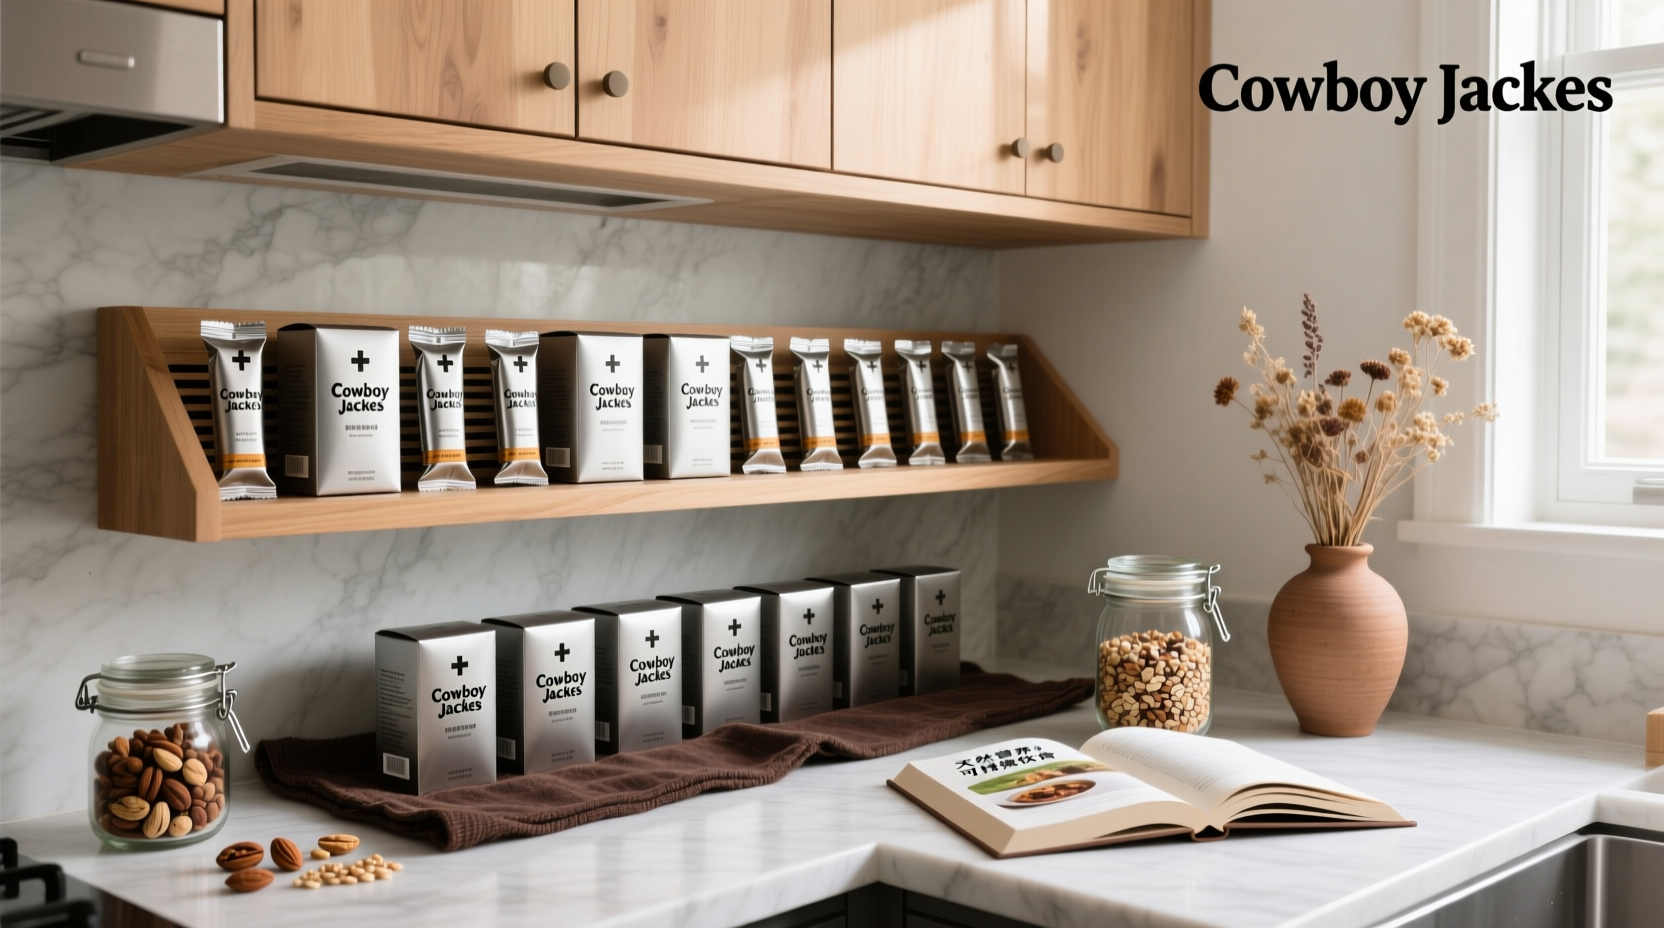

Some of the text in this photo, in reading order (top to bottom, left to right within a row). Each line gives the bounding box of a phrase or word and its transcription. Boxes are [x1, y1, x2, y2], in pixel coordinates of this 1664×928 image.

[331, 382, 389, 400] Cowboy
[338, 399, 384, 415] Jackes
[629, 655, 675, 672] Cowboy
[535, 671, 587, 689] Cowboy
[431, 685, 487, 703] Cowboy
[542, 685, 582, 703] Jackes
[438, 699, 482, 719] Jackes
